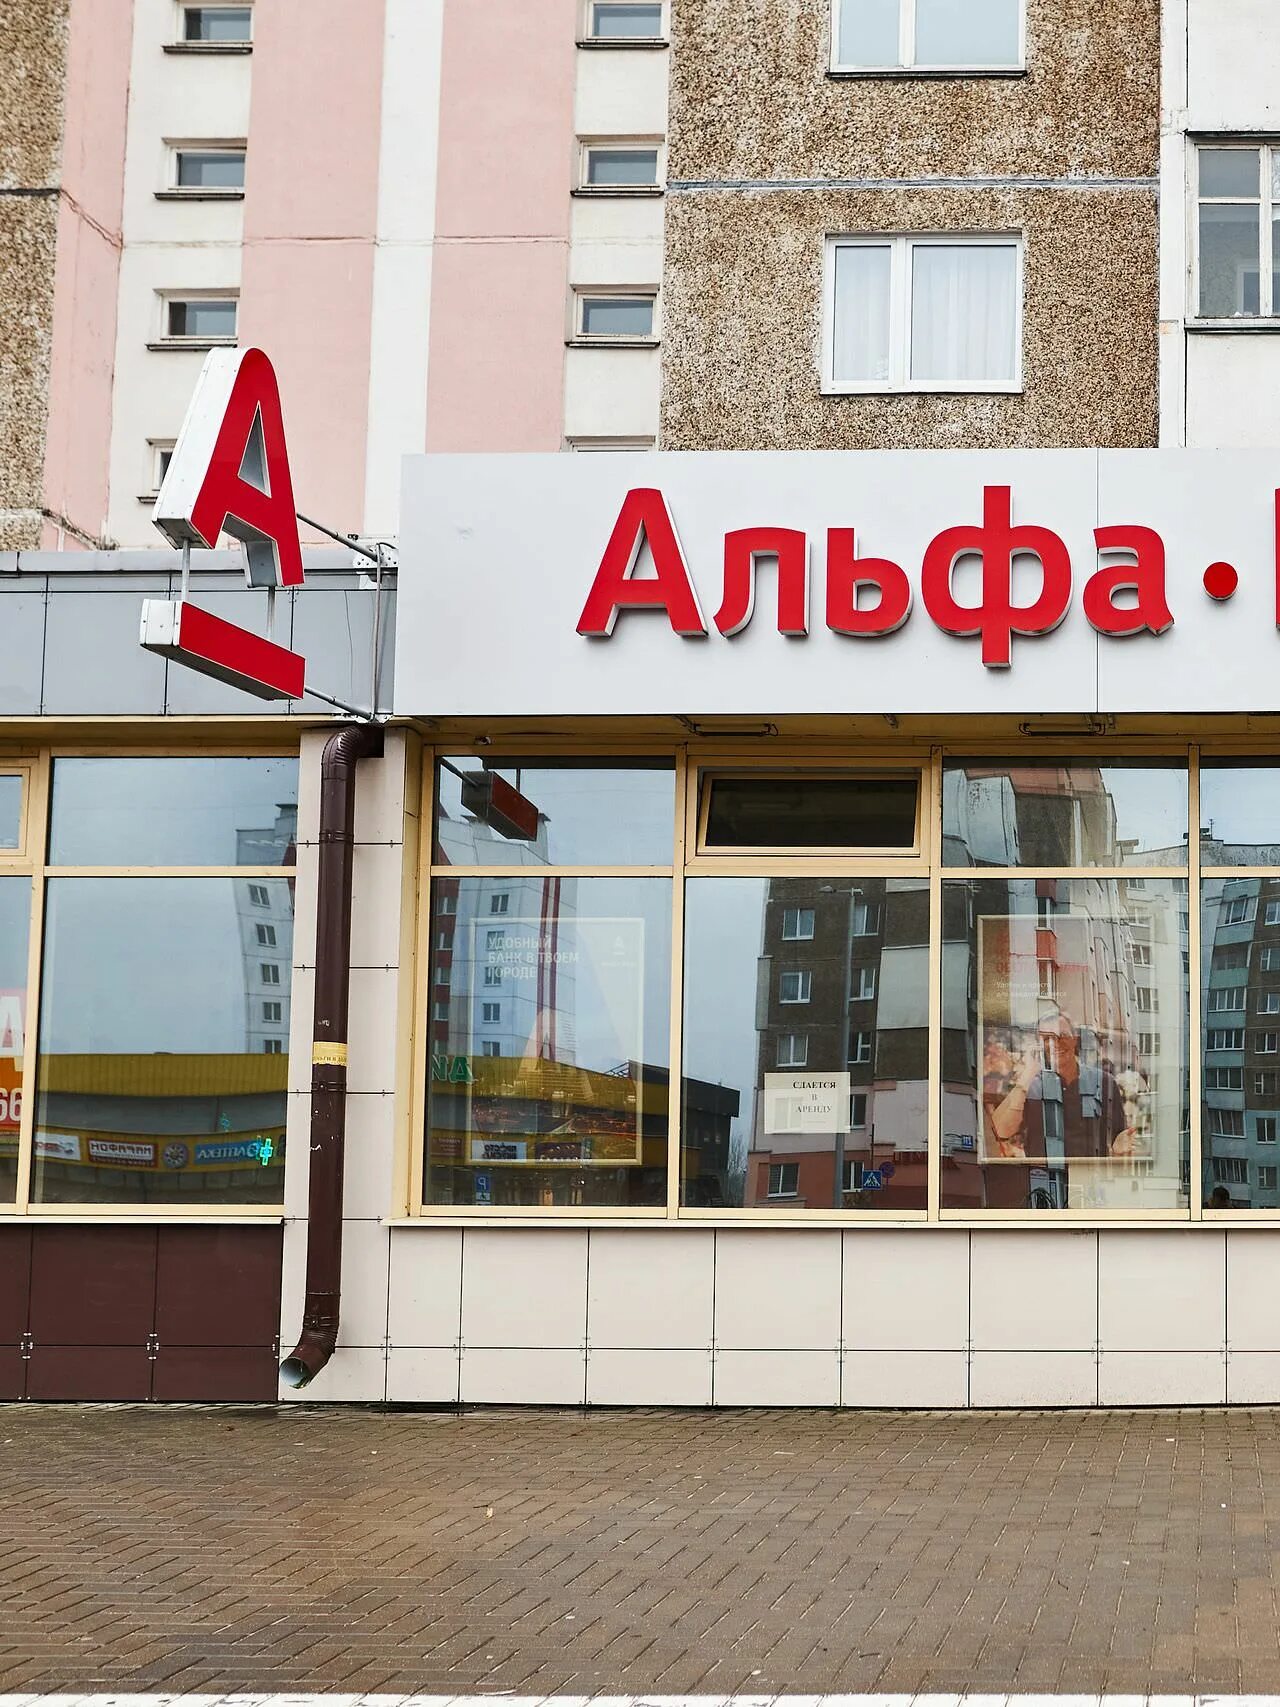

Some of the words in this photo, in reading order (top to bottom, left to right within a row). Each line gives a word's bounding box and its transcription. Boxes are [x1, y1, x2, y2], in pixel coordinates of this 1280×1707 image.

[488, 935, 552, 950] УДОБНЫЙ
[488, 952, 523, 964] БАНК
[527, 952, 535, 964] В
[538, 952, 580, 964] ТВОЕМ
[488, 966, 538, 980] ГОРОДЕ
[793, 1081, 837, 1090] СДАЕТСЯ
[811, 1093, 818, 1101] В
[796, 1105, 832, 1113] АРЕНДУ
